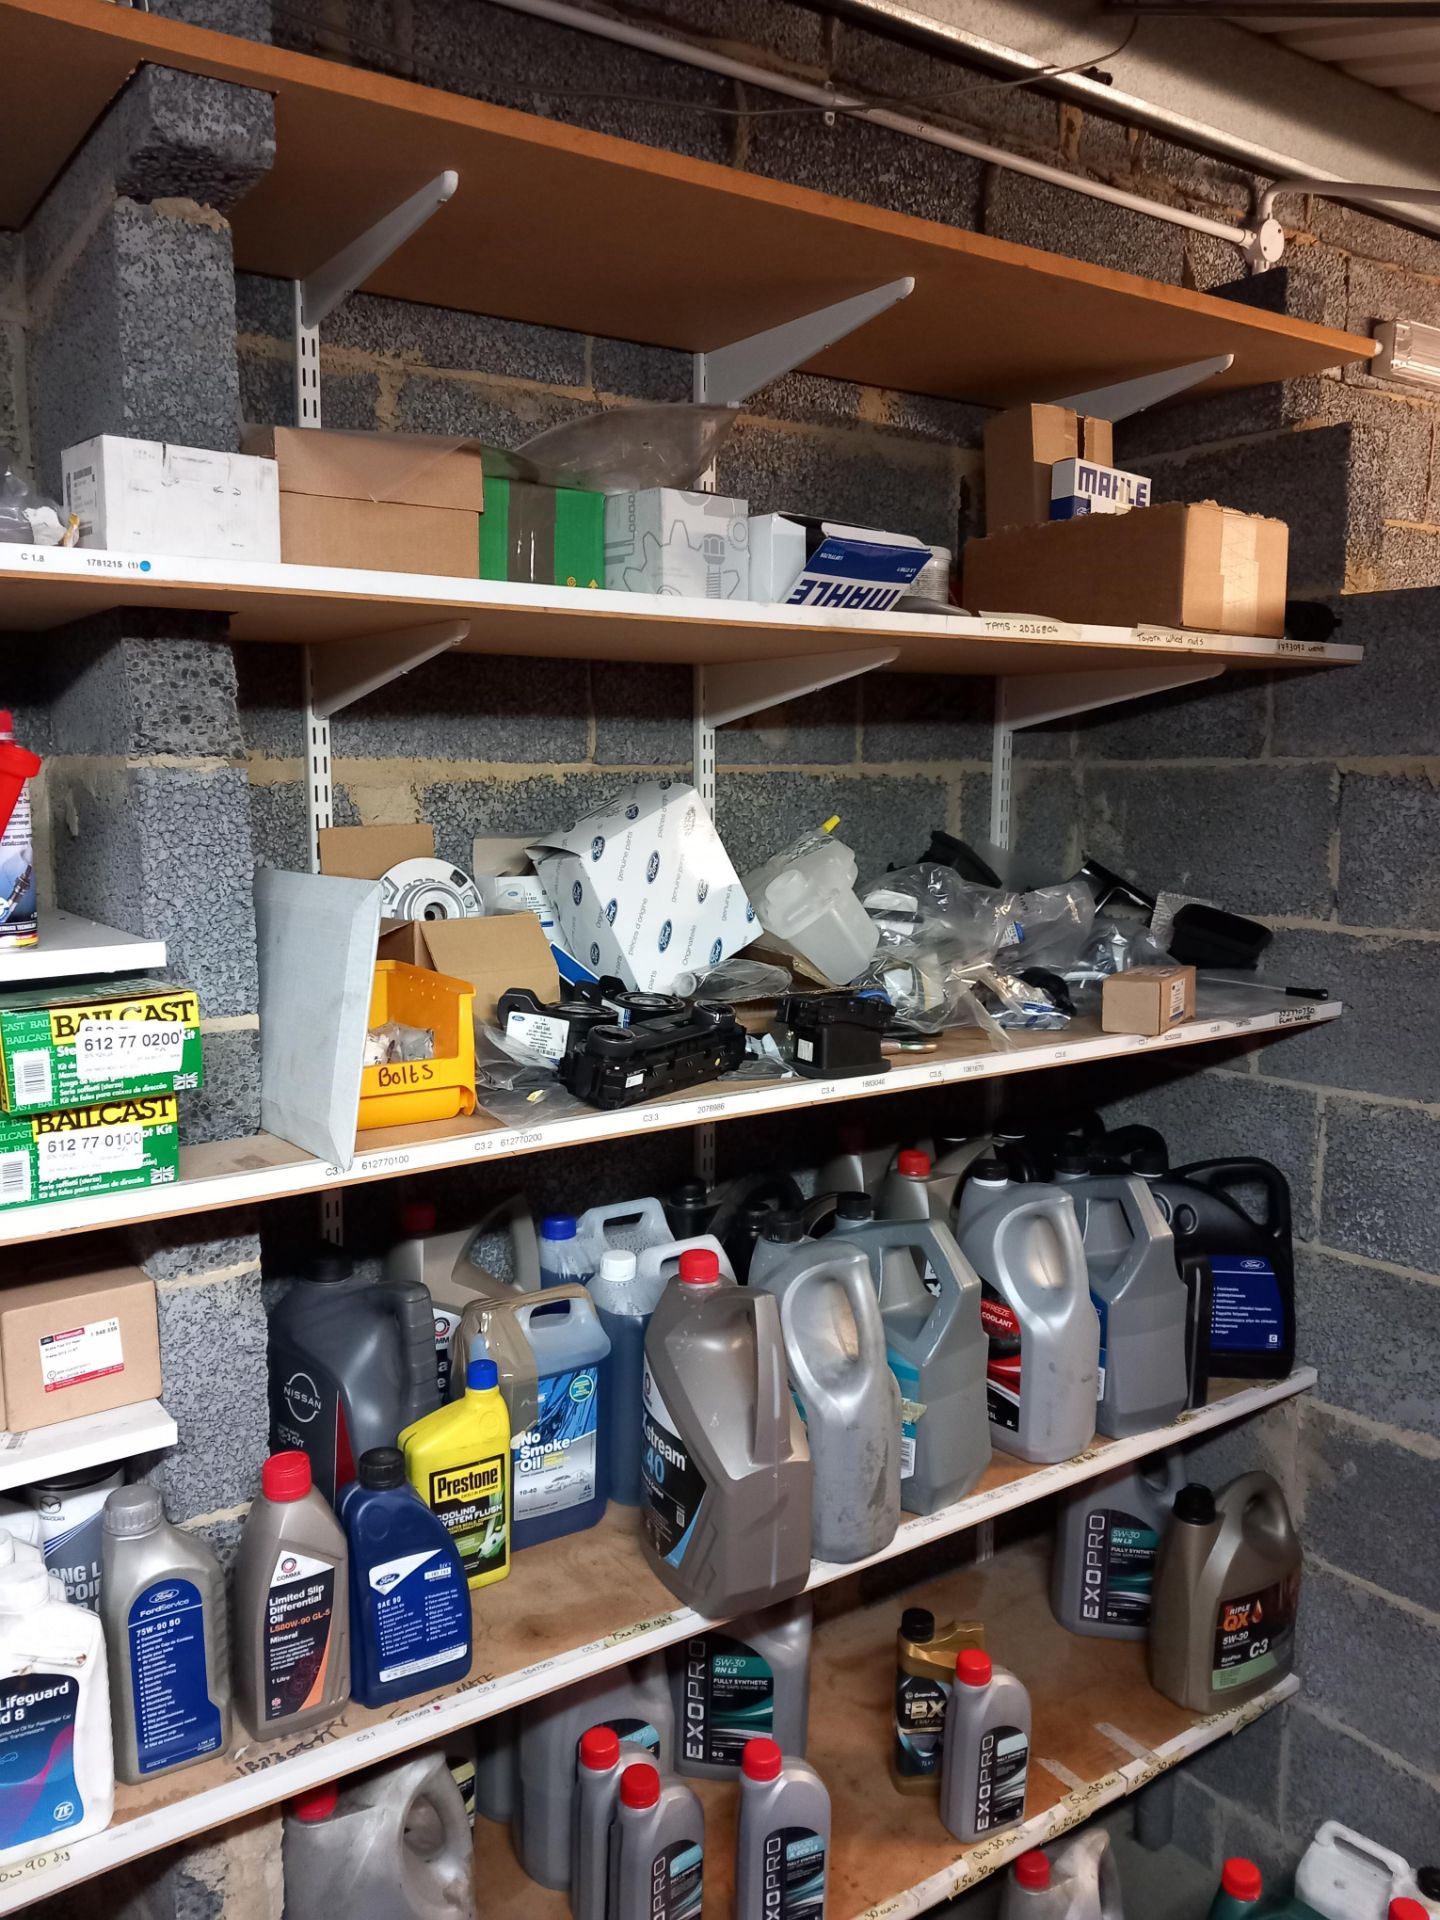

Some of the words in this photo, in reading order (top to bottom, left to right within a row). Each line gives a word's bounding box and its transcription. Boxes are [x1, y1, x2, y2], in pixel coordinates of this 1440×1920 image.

[21, 552, 29, 561] C
[31, 553, 45, 563] 1.8
[86, 559, 123, 569] 1781215
[127, 561, 139, 570] (1)
[785, 579, 901, 612] MAHLE
[84, 1037, 113, 1052] 612
[118, 1035, 136, 1048] 77
[142, 1031, 180, 1047] 0200
[378, 1063, 434, 1088] Bolts
[34, 1095, 174, 1135] BAILCAST
[156, 1124, 174, 1136] Kit
[48, 1138, 76, 1153] 612
[82, 1136, 100, 1149] 77
[104, 1131, 142, 1147] 0100
[500, 1133, 543, 1148] 612770200
[362, 1154, 410, 1170] 612770100
[982, 1312, 1013, 1328] COOLANT
[284, 1386, 321, 1410] NISSAN
[520, 1432, 541, 1446] No
[520, 1438, 570, 1459] Smoke
[520, 1457, 541, 1472] Oil
[437, 1467, 498, 1499] Prestone
[442, 1514, 473, 1528] YSTEM
[474, 1503, 502, 1519] FLUSH
[1112, 1530, 1140, 1538] 5W-30
[50, 1566, 86, 1584] ONG
[1083, 1515, 1105, 1619] EXOPRO
[377, 1574, 398, 1586] Ford
[152, 1590, 177, 1602] Ford
[270, 1590, 305, 1607] Limited
[307, 1584, 324, 1597] Slip
[377, 1598, 391, 1610] SAE
[392, 1596, 402, 1604] 90
[140, 1598, 190, 1618] FordService
[270, 1596, 322, 1616] Differential
[136, 1620, 168, 1638] 75W-90
[270, 1616, 284, 1625] Oil
[270, 1616, 310, 1634] LS80W-90
[312, 1608, 331, 1622] GL-5
[1224, 1612, 1248, 1632] QX
[270, 1631, 298, 1645] Mineral
[1222, 1631, 1249, 1646] 5W-30
[1250, 1638, 1268, 1658] C3
[714, 1658, 746, 1668] 5W-30
[0, 1682, 70, 1712] Lifeguard
[686, 1640, 706, 1760] EXOPRO
[14, 1708, 25, 1721] 8
[911, 1700, 946, 1720] BX
[976, 1735, 994, 1831] EXOPRO
[56, 1806, 72, 1818] ZF
[26, 1858, 47, 1871] 90
[766, 1838, 781, 1920] XOPRO
